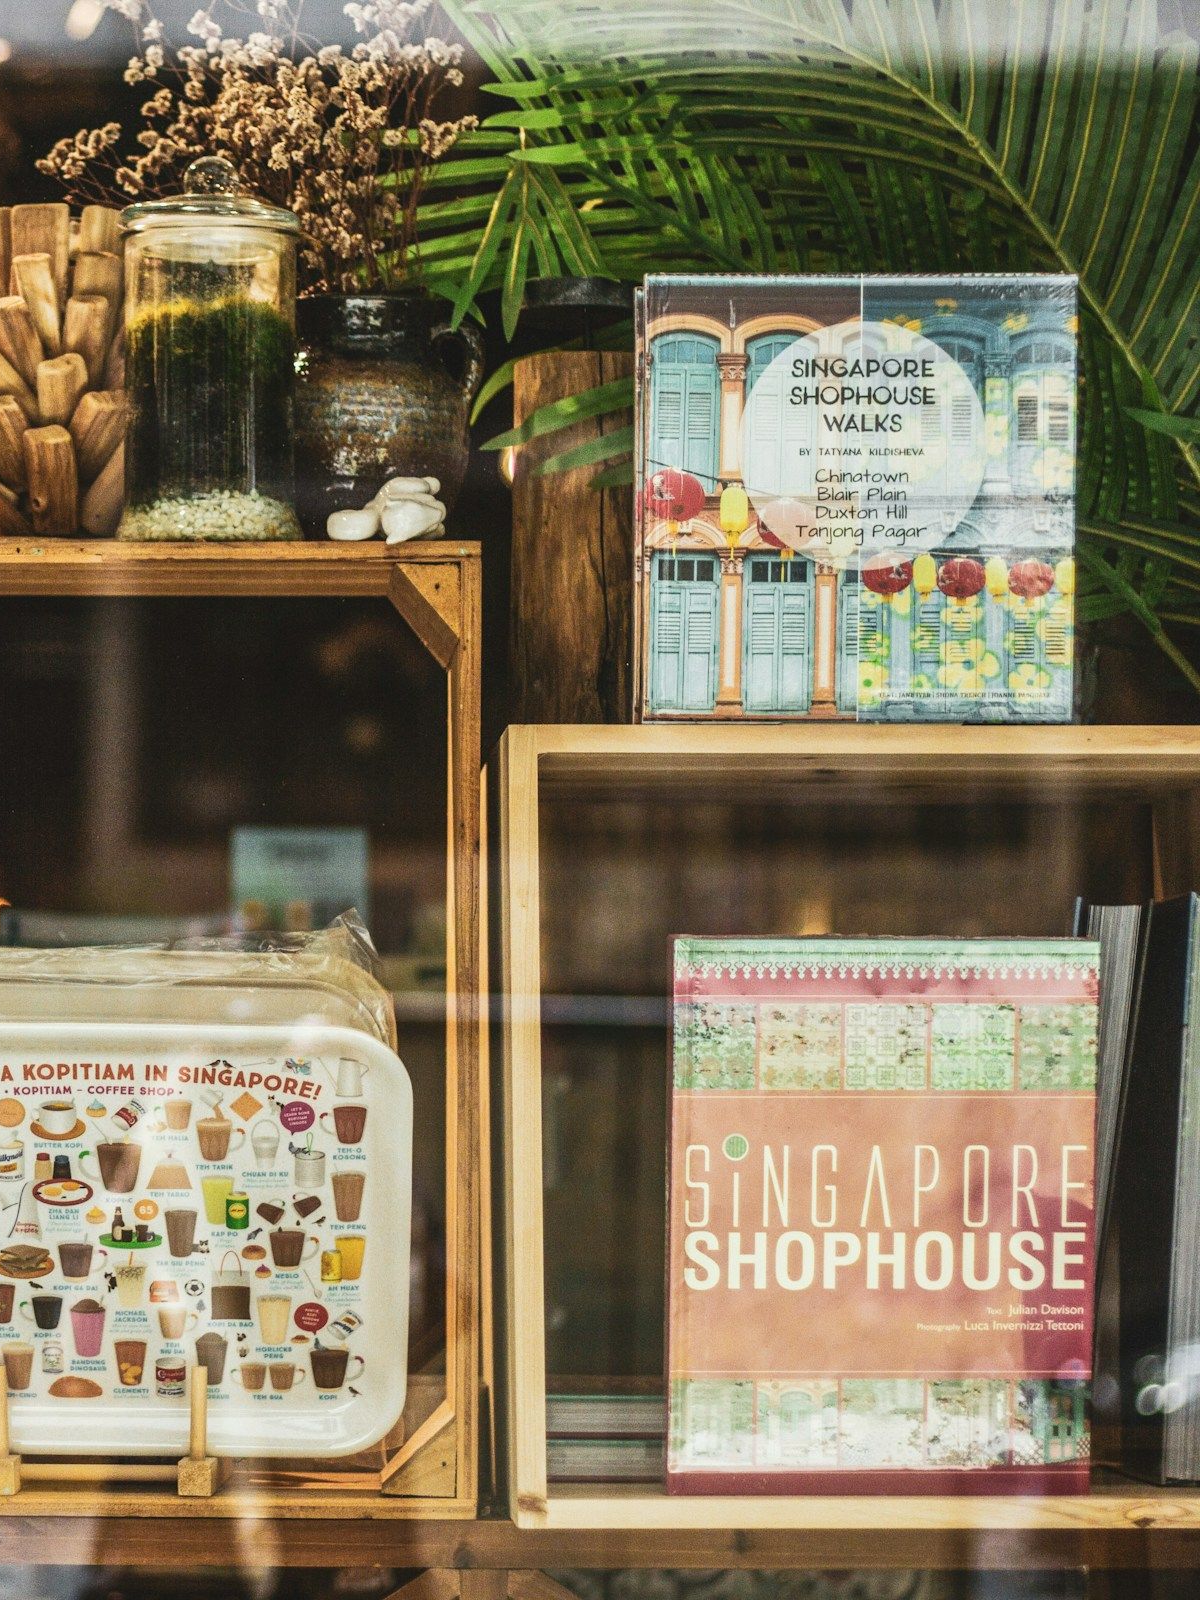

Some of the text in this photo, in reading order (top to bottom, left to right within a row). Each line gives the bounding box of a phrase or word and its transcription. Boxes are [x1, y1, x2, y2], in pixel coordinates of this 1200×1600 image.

[791, 358, 935, 378] SINGAPORE
[790, 387, 936, 406] SHOPHOUSE
[823, 414, 903, 432] WALKS
[799, 448, 925, 456] BY TATYANA KILDISHEVA
[815, 468, 909, 483] Chinatown
[817, 486, 907, 501] Blair Plain
[815, 505, 908, 520] Duxton Hill
[795, 524, 927, 546] Tanjong Pagar
[1, 1065, 14, 1082] A
[23, 1064, 135, 1081] KOPITIAM
[145, 1065, 168, 1081] IN
[178, 1066, 322, 1100] SINGAPORE!
[14, 1086, 174, 1096] KOPITIAM COFFEE SHOP
[139, 1206, 153, 1214] 65
[683, 1231, 1085, 1291] SHOPHOUSE
[1008, 1304, 1037, 1317] Julian
[1041, 1304, 1084, 1315] Davison
[917, 1320, 1084, 1332] Photography Luca Invernizzi Tettoni
